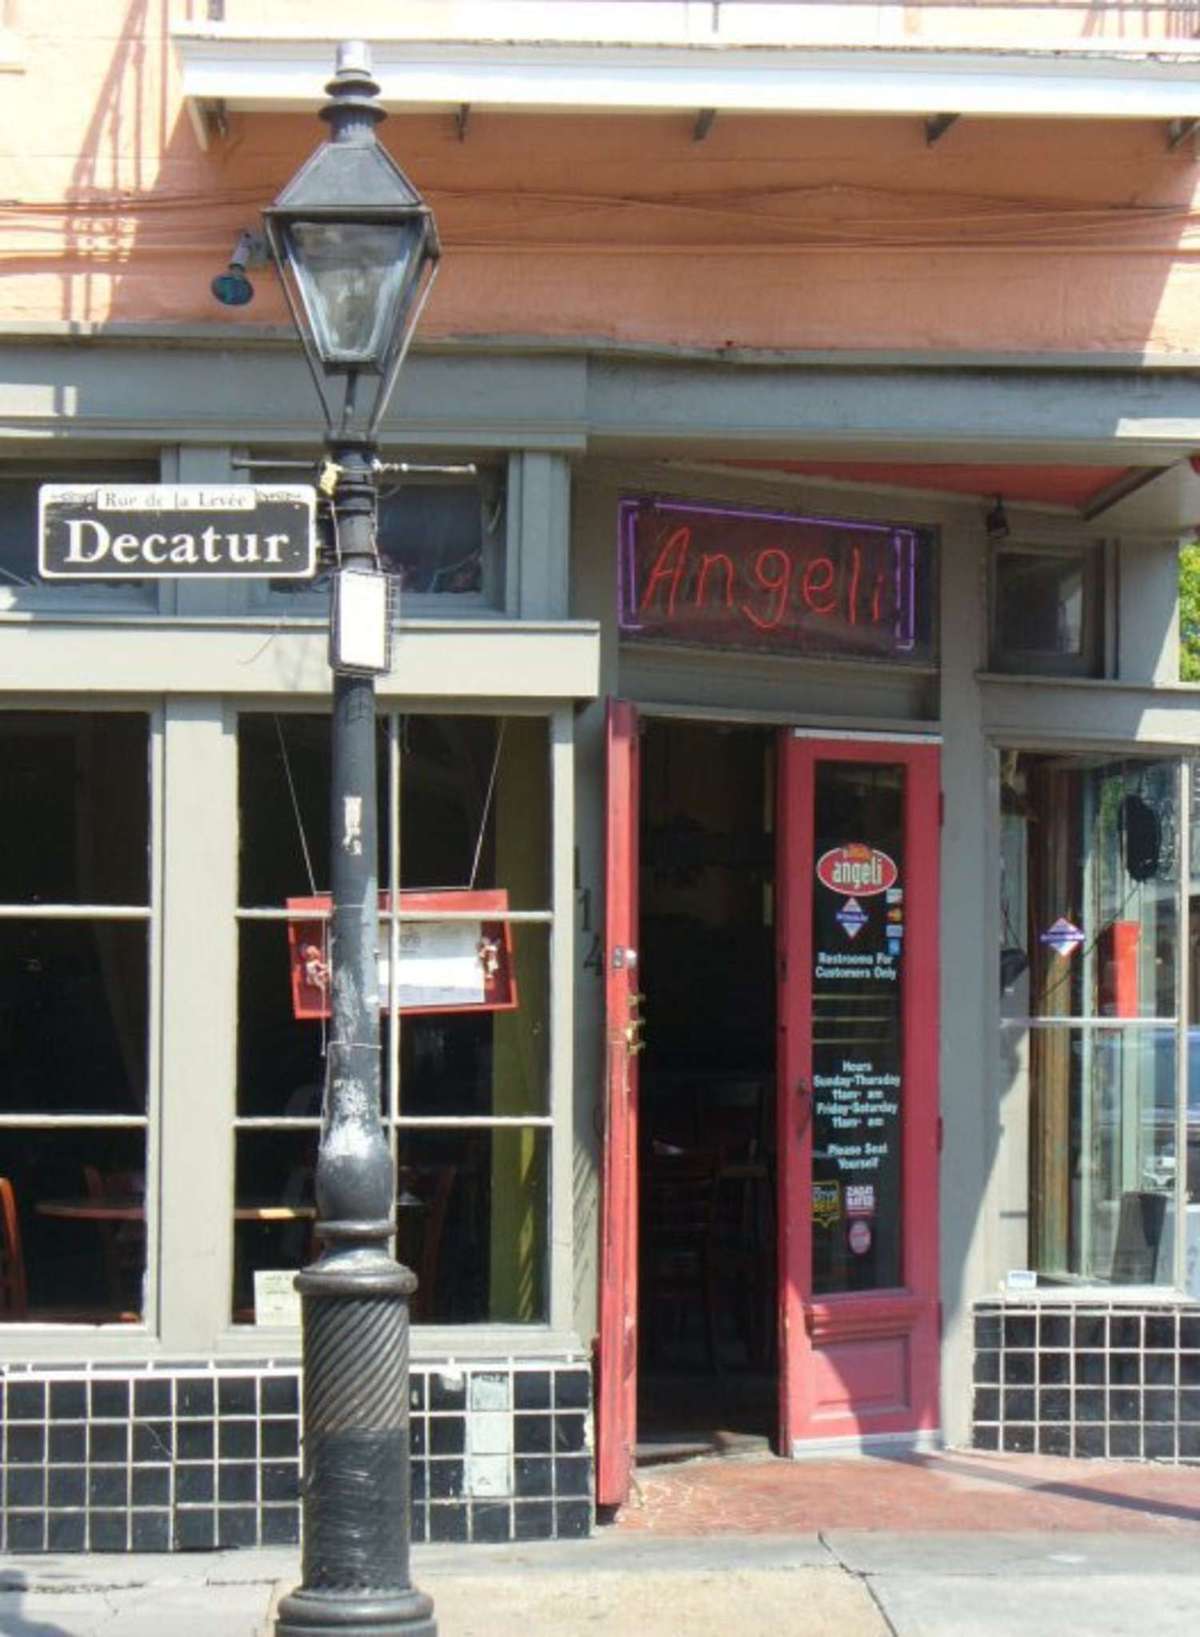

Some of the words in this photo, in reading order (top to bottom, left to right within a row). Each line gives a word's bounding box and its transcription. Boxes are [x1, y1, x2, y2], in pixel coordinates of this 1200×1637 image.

[104, 491, 138, 508] Rue
[144, 492, 164, 508] de
[174, 491, 190, 509] la
[63, 518, 290, 564] Decatur
[641, 526, 884, 629] Angeli
[832, 854, 883, 890] angeli
[818, 952, 874, 965] Restrooms
[876, 952, 893, 964] For
[815, 966, 871, 979] Customers
[874, 967, 897, 980] Only
[827, 1143, 862, 1155] Please
[864, 1142, 888, 1155] Seat
[838, 1157, 879, 1169] Yourself
